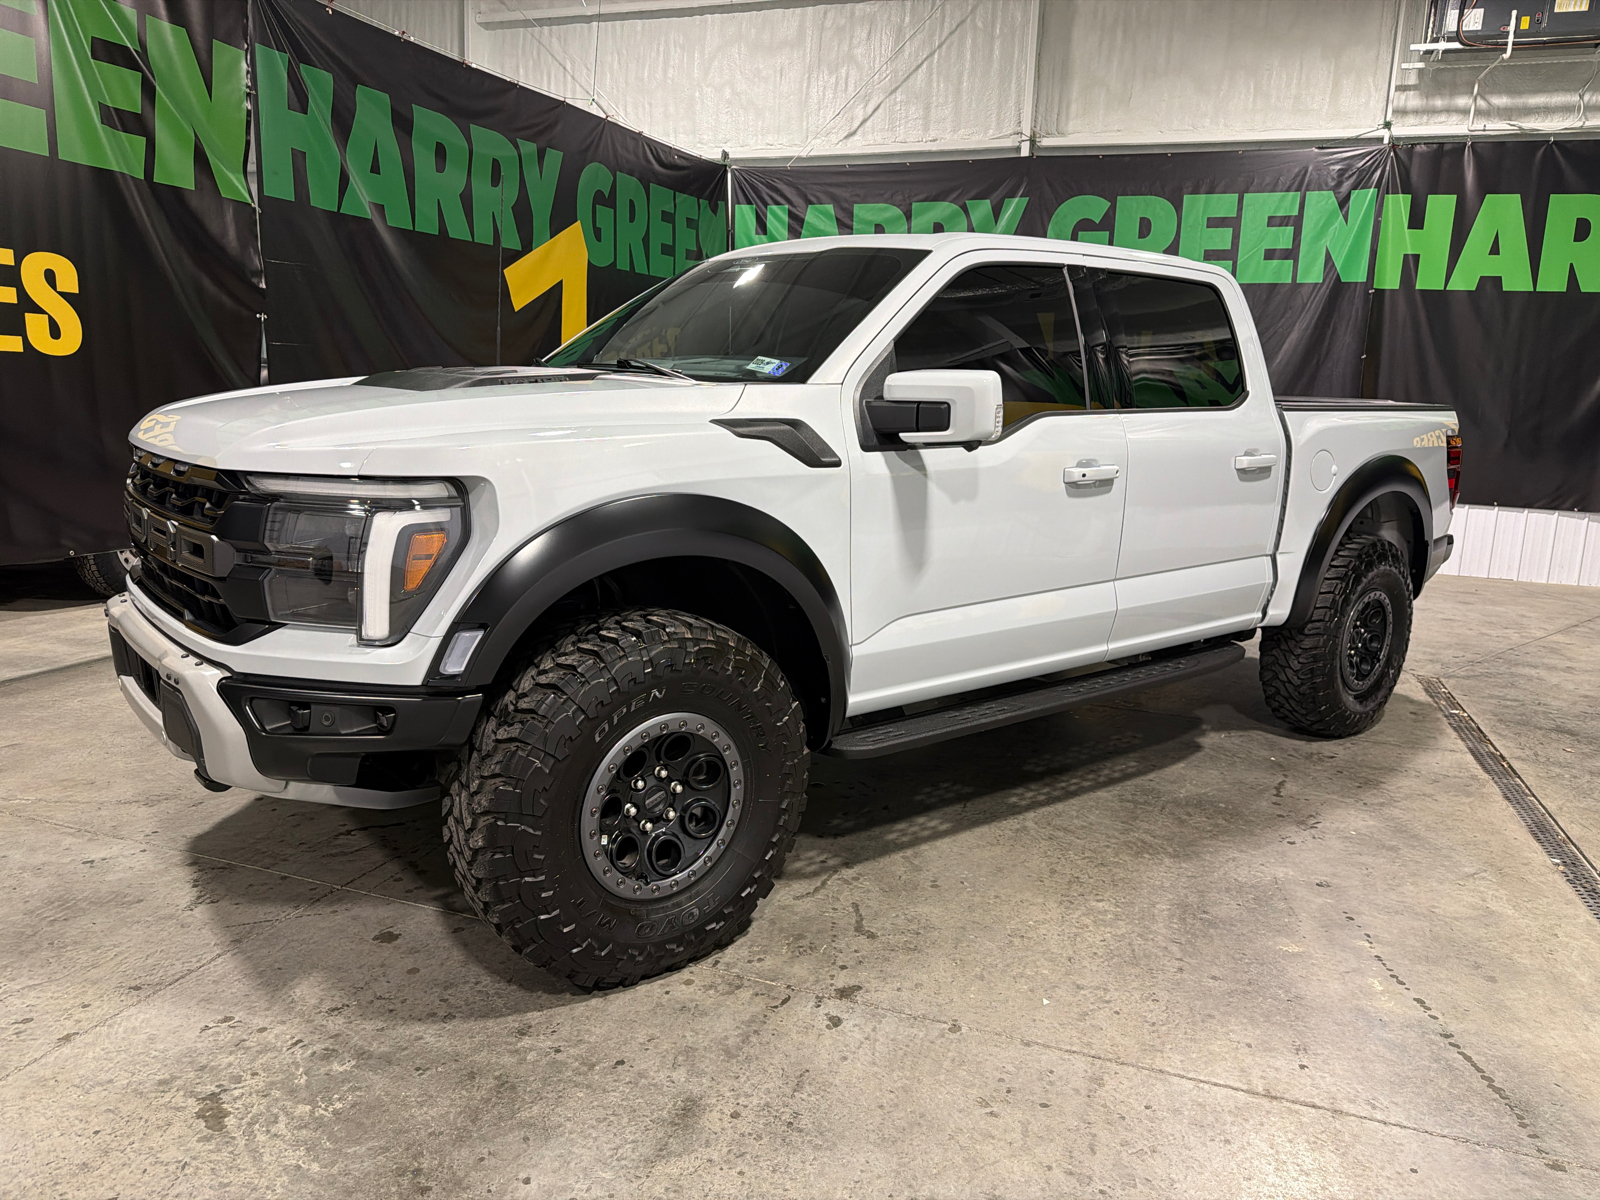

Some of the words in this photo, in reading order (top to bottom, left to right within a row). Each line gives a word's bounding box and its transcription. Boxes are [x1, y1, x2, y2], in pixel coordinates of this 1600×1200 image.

[255, 42, 563, 250] HARRY
[577, 162, 727, 278] GREEN
[1373, 193, 1600, 292] HAR
[124, 492, 229, 577] ORD
[594, 686, 666, 743] OPEN
[679, 682, 772, 753] COUNTRY
[635, 893, 721, 938] TOYO
